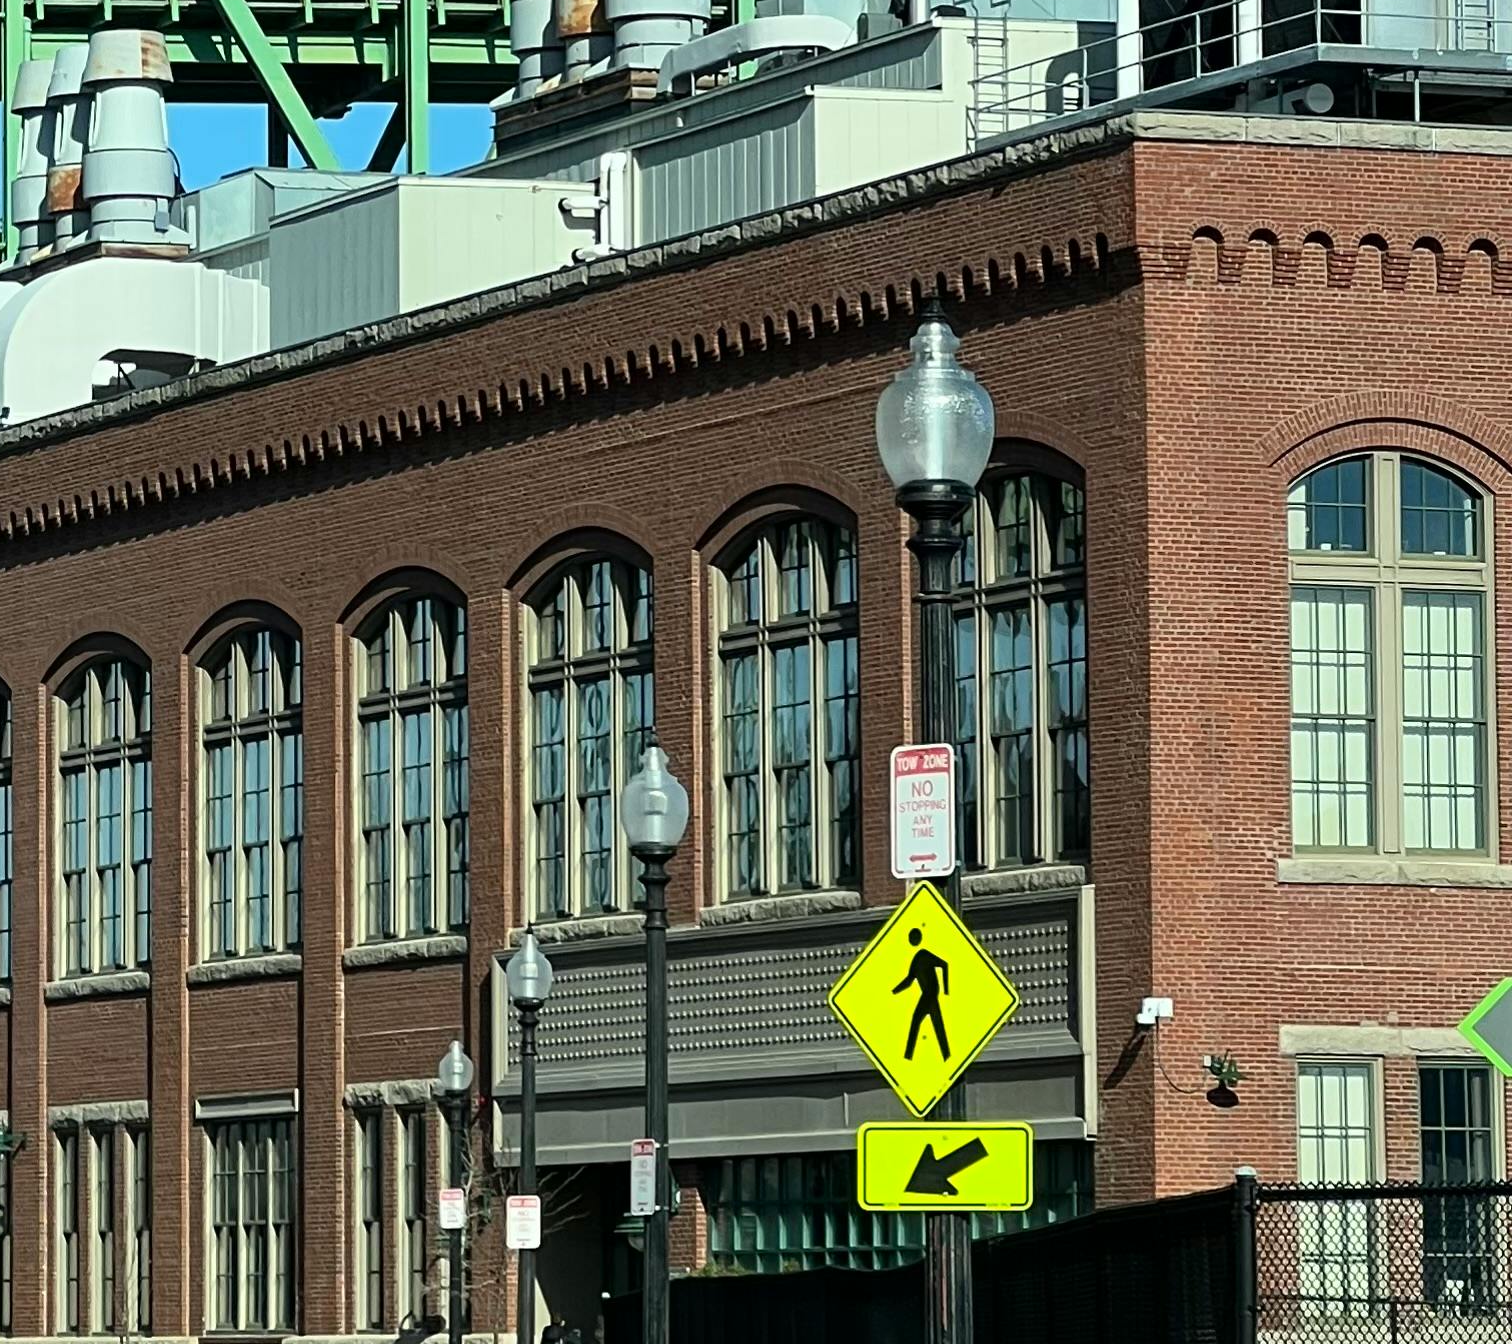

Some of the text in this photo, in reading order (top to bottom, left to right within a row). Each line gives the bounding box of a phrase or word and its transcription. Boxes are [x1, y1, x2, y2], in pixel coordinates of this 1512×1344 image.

[896, 754, 948, 771] TOW ZONE
[912, 780, 933, 797] NO
[899, 799, 946, 812] STOPPING
[913, 815, 932, 825] ANY
[912, 827, 934, 837] TIME
